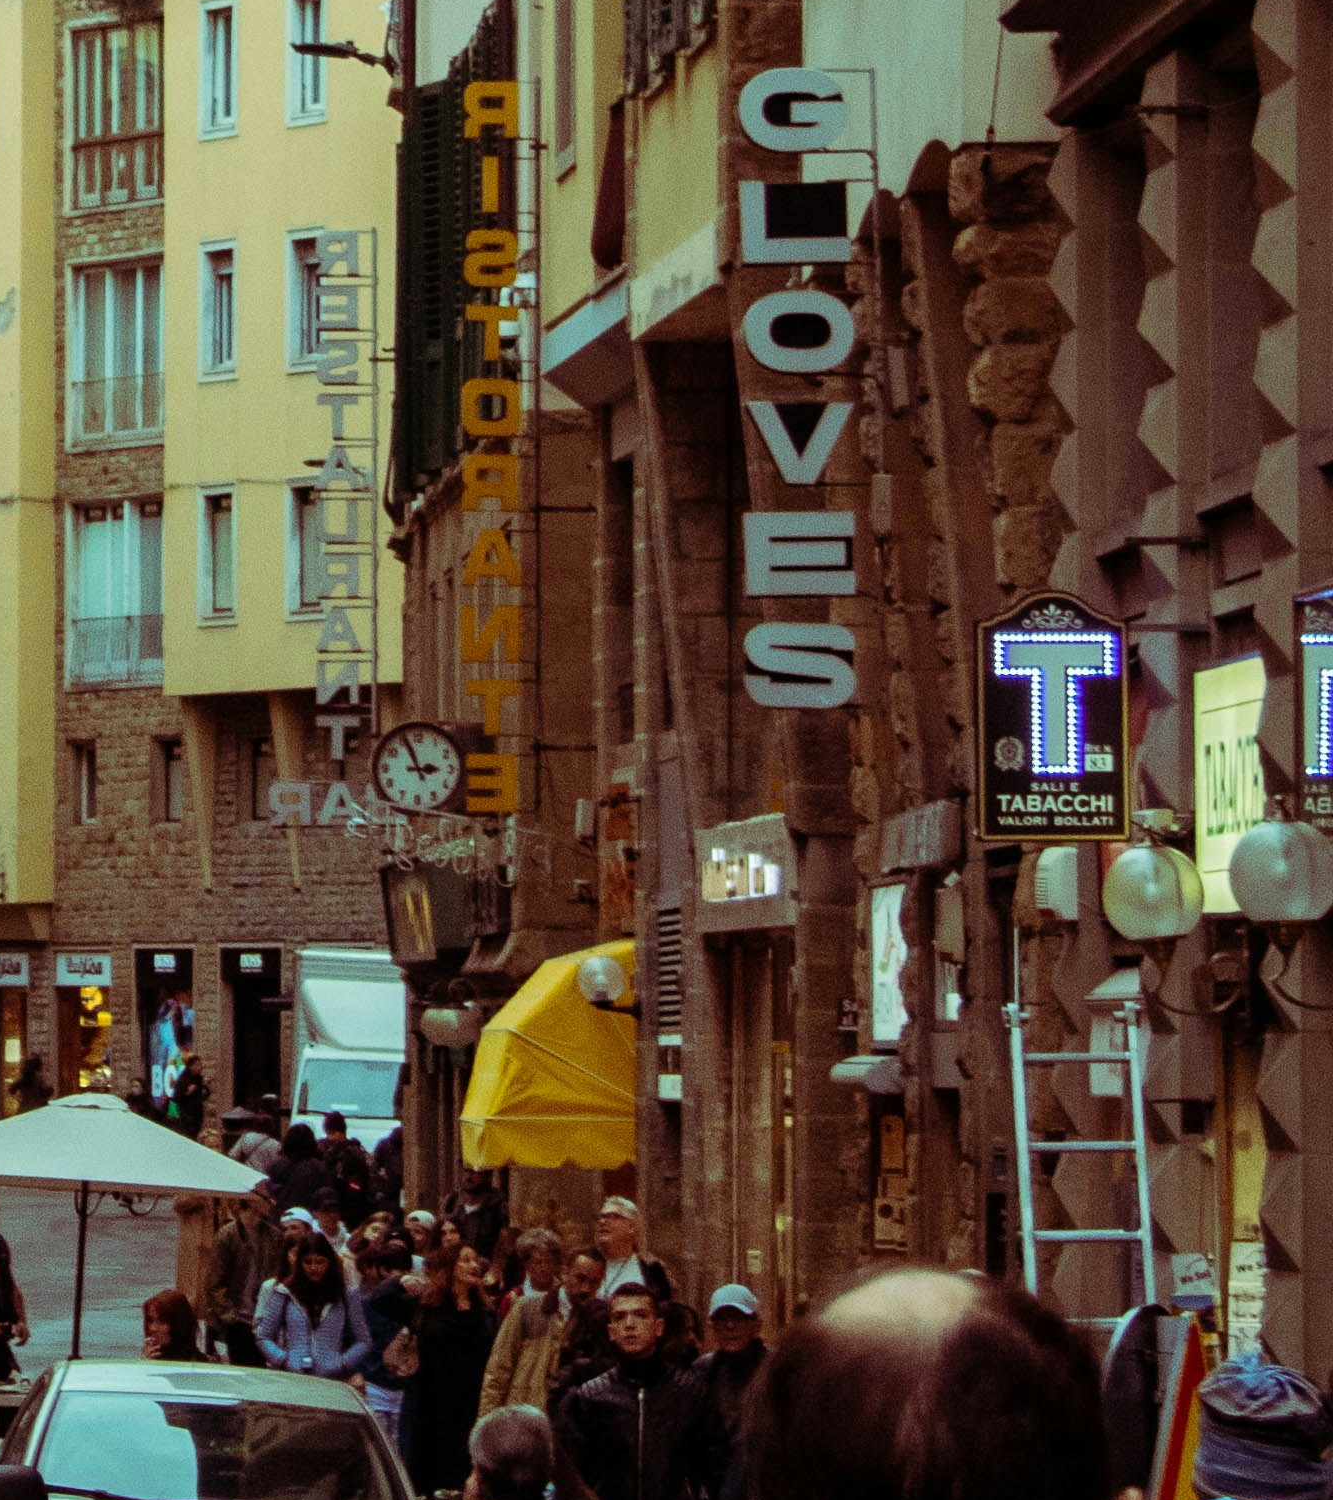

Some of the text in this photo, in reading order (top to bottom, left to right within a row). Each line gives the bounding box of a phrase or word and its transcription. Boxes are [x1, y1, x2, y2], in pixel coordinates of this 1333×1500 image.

[738, 66, 858, 709] GLOVES
[994, 631, 1115, 774] T
[1030, 782, 1079, 792] SALI E
[996, 795, 1114, 813] TABACCHI
[997, 815, 1114, 826] VALORI BOLLATI
